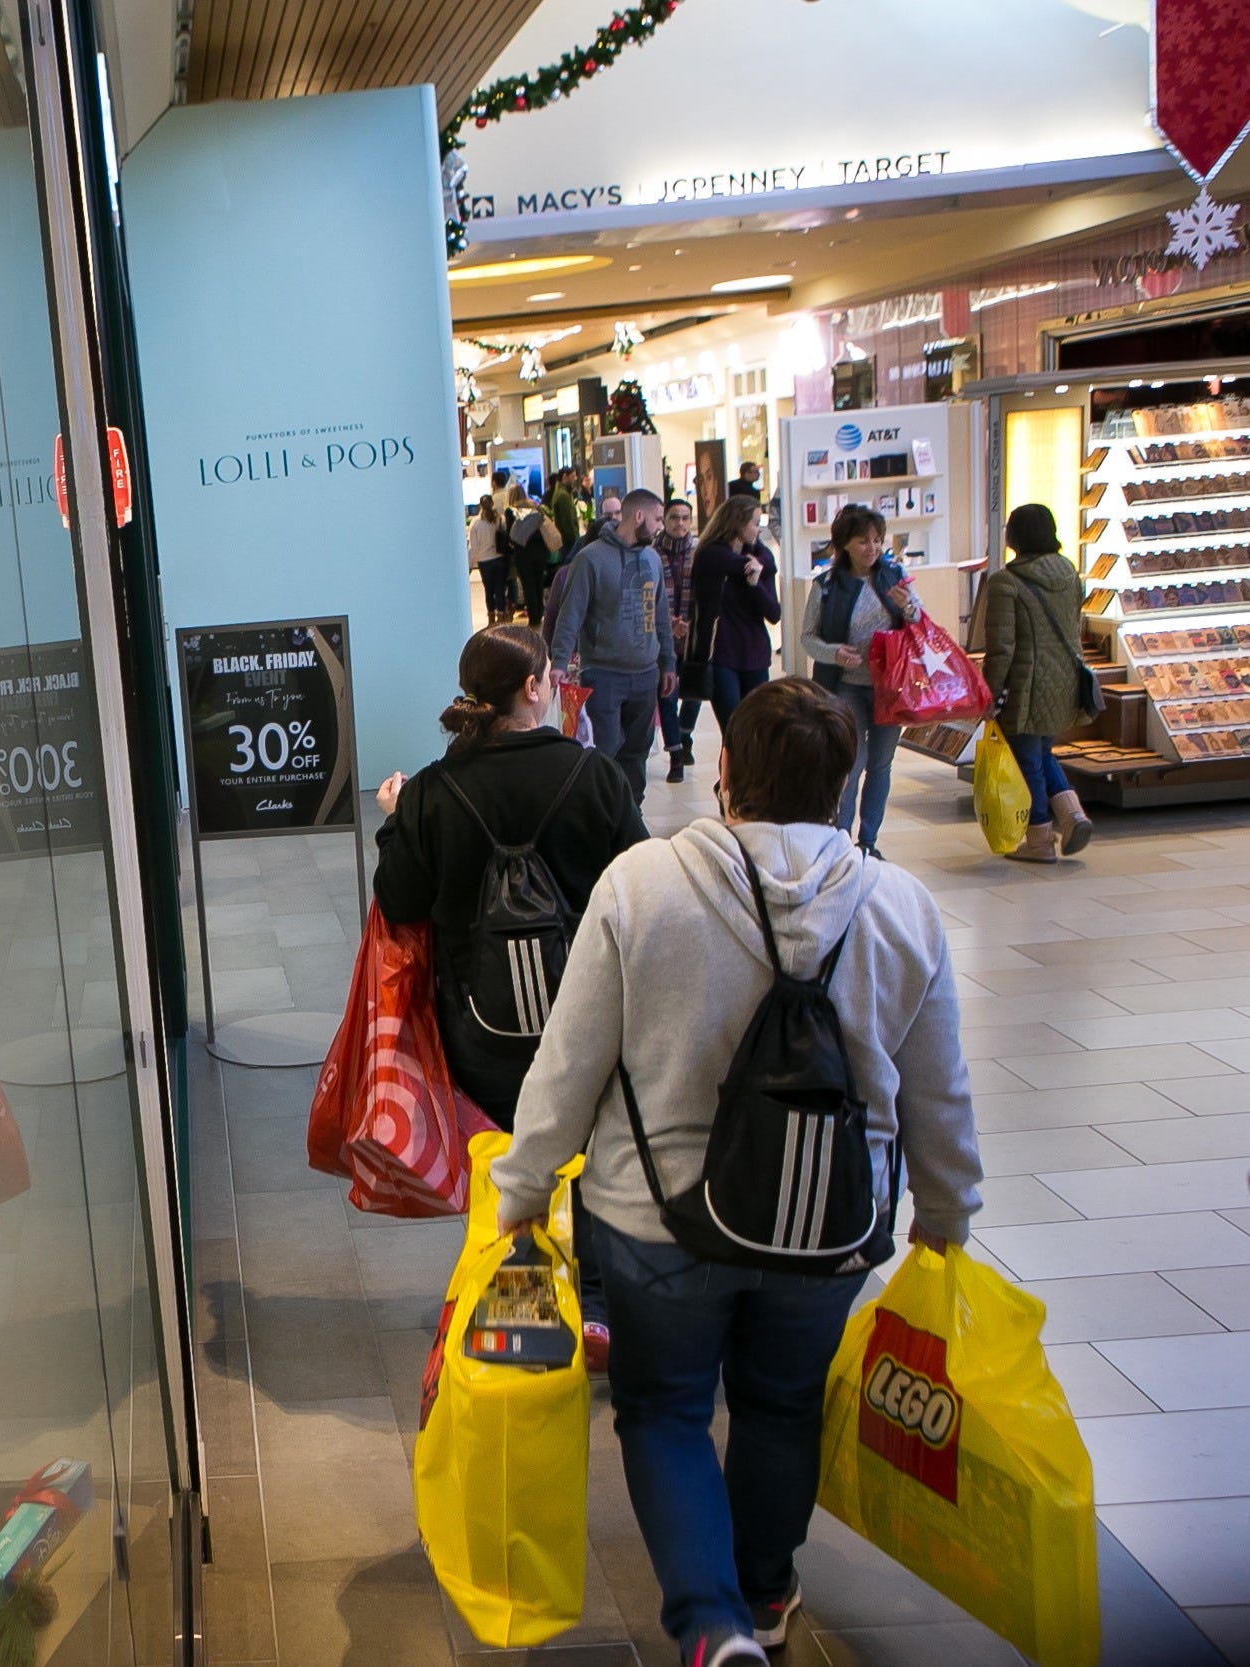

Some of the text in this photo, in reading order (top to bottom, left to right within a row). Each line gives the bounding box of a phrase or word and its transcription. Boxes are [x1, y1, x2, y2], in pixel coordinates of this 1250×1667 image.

[517, 151, 950, 215] MACY'S JCPENNEY TARGET
[246, 422, 365, 442] PURVEYORS OF SWEETNESS
[867, 427, 901, 442] AT&T
[113, 448, 125, 489] FIRE
[199, 436, 415, 486] LOLLI & POPS
[642, 588, 655, 634] FACE
[213, 650, 318, 675] BLACK. FRIDAY.
[244, 669, 287, 688] EVENT
[228, 719, 316, 773] 30%
[291, 754, 321, 769] OFF
[220, 777, 244, 786] YOUR
[247, 774, 277, 784] ENTIRE
[255, 799, 294, 811] Clarks
[867, 1356, 955, 1444] LEGO
